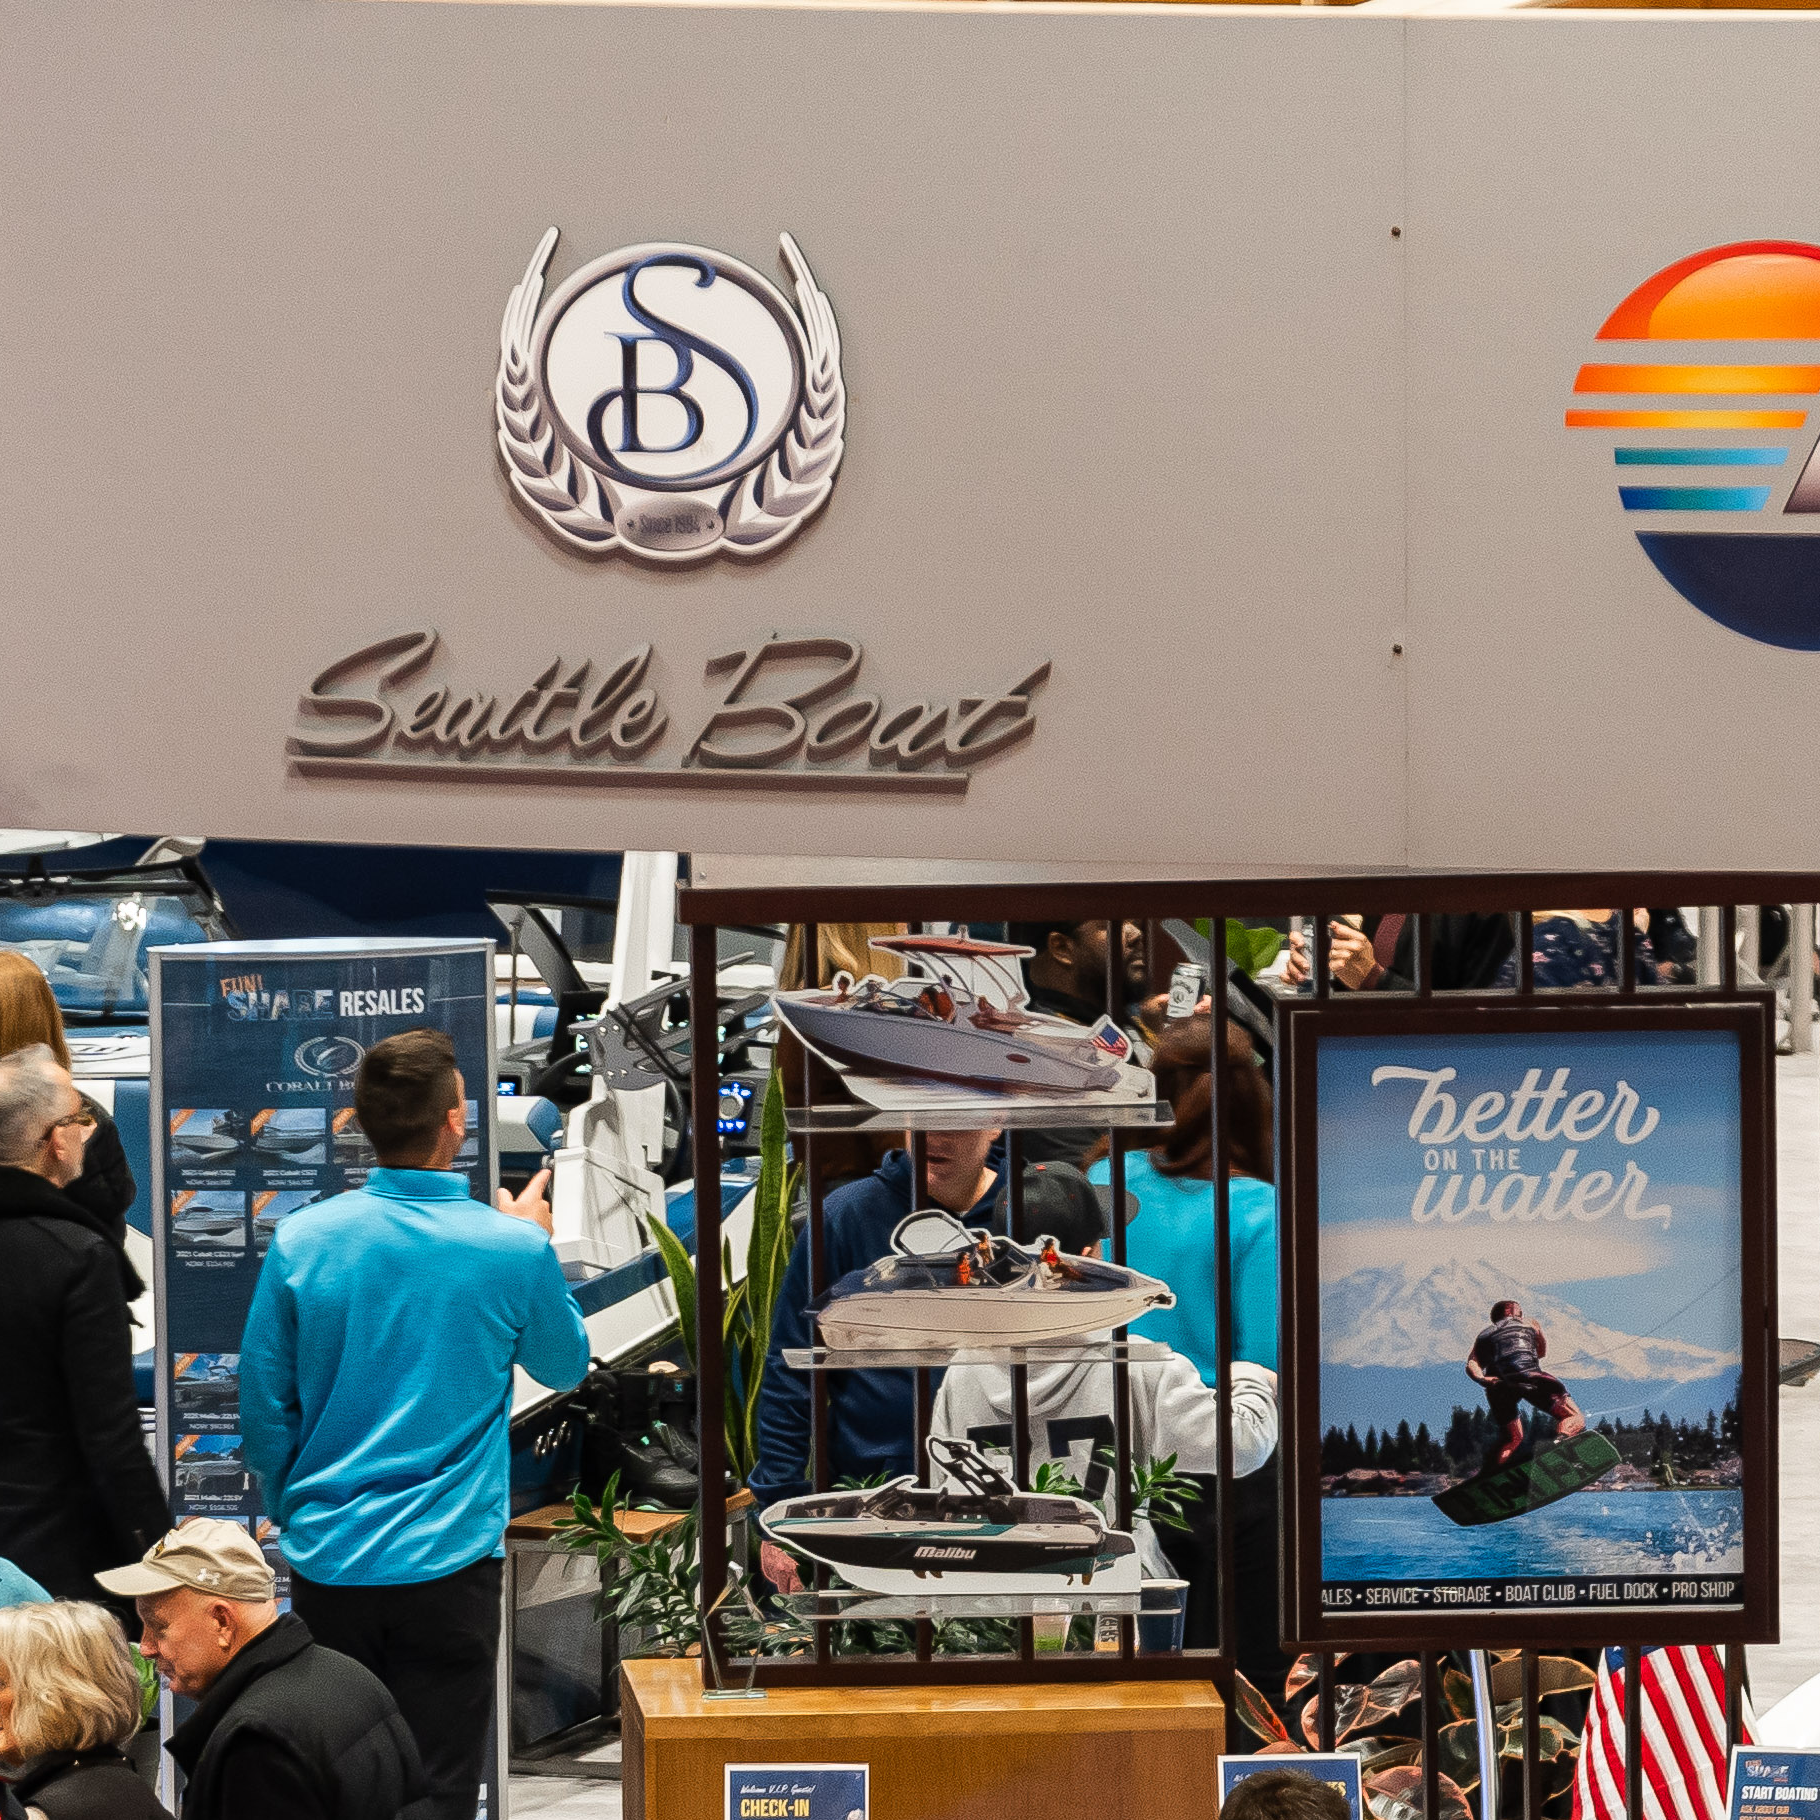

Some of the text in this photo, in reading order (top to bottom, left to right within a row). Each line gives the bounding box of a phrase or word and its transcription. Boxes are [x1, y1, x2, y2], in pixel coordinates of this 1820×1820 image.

[286, 625, 1053, 770] Seattle Boat
[339, 987, 426, 1017] RESALES
[1370, 1065, 1661, 1145] better
[1423, 1148, 1521, 1172] ON THE
[1411, 1149, 1673, 1229] water
[913, 1546, 978, 1560] Malibu
[1366, 1587, 1420, 1605] SERVICE
[1433, 1586, 1492, 1604] STORAGE
[1505, 1585, 1539, 1602] BOAT
[1542, 1584, 1576, 1601] CLUB
[1589, 1583, 1621, 1601] FUEL
[1623, 1583, 1659, 1599] DOCK
[1672, 1582, 1698, 1599] PRO
[1700, 1581, 1736, 1598] SHOP
[1741, 1785, 1775, 1800] START
[1774, 1786, 1818, 1801] BOATING
[740, 1798, 810, 1818] CHECK-IN
